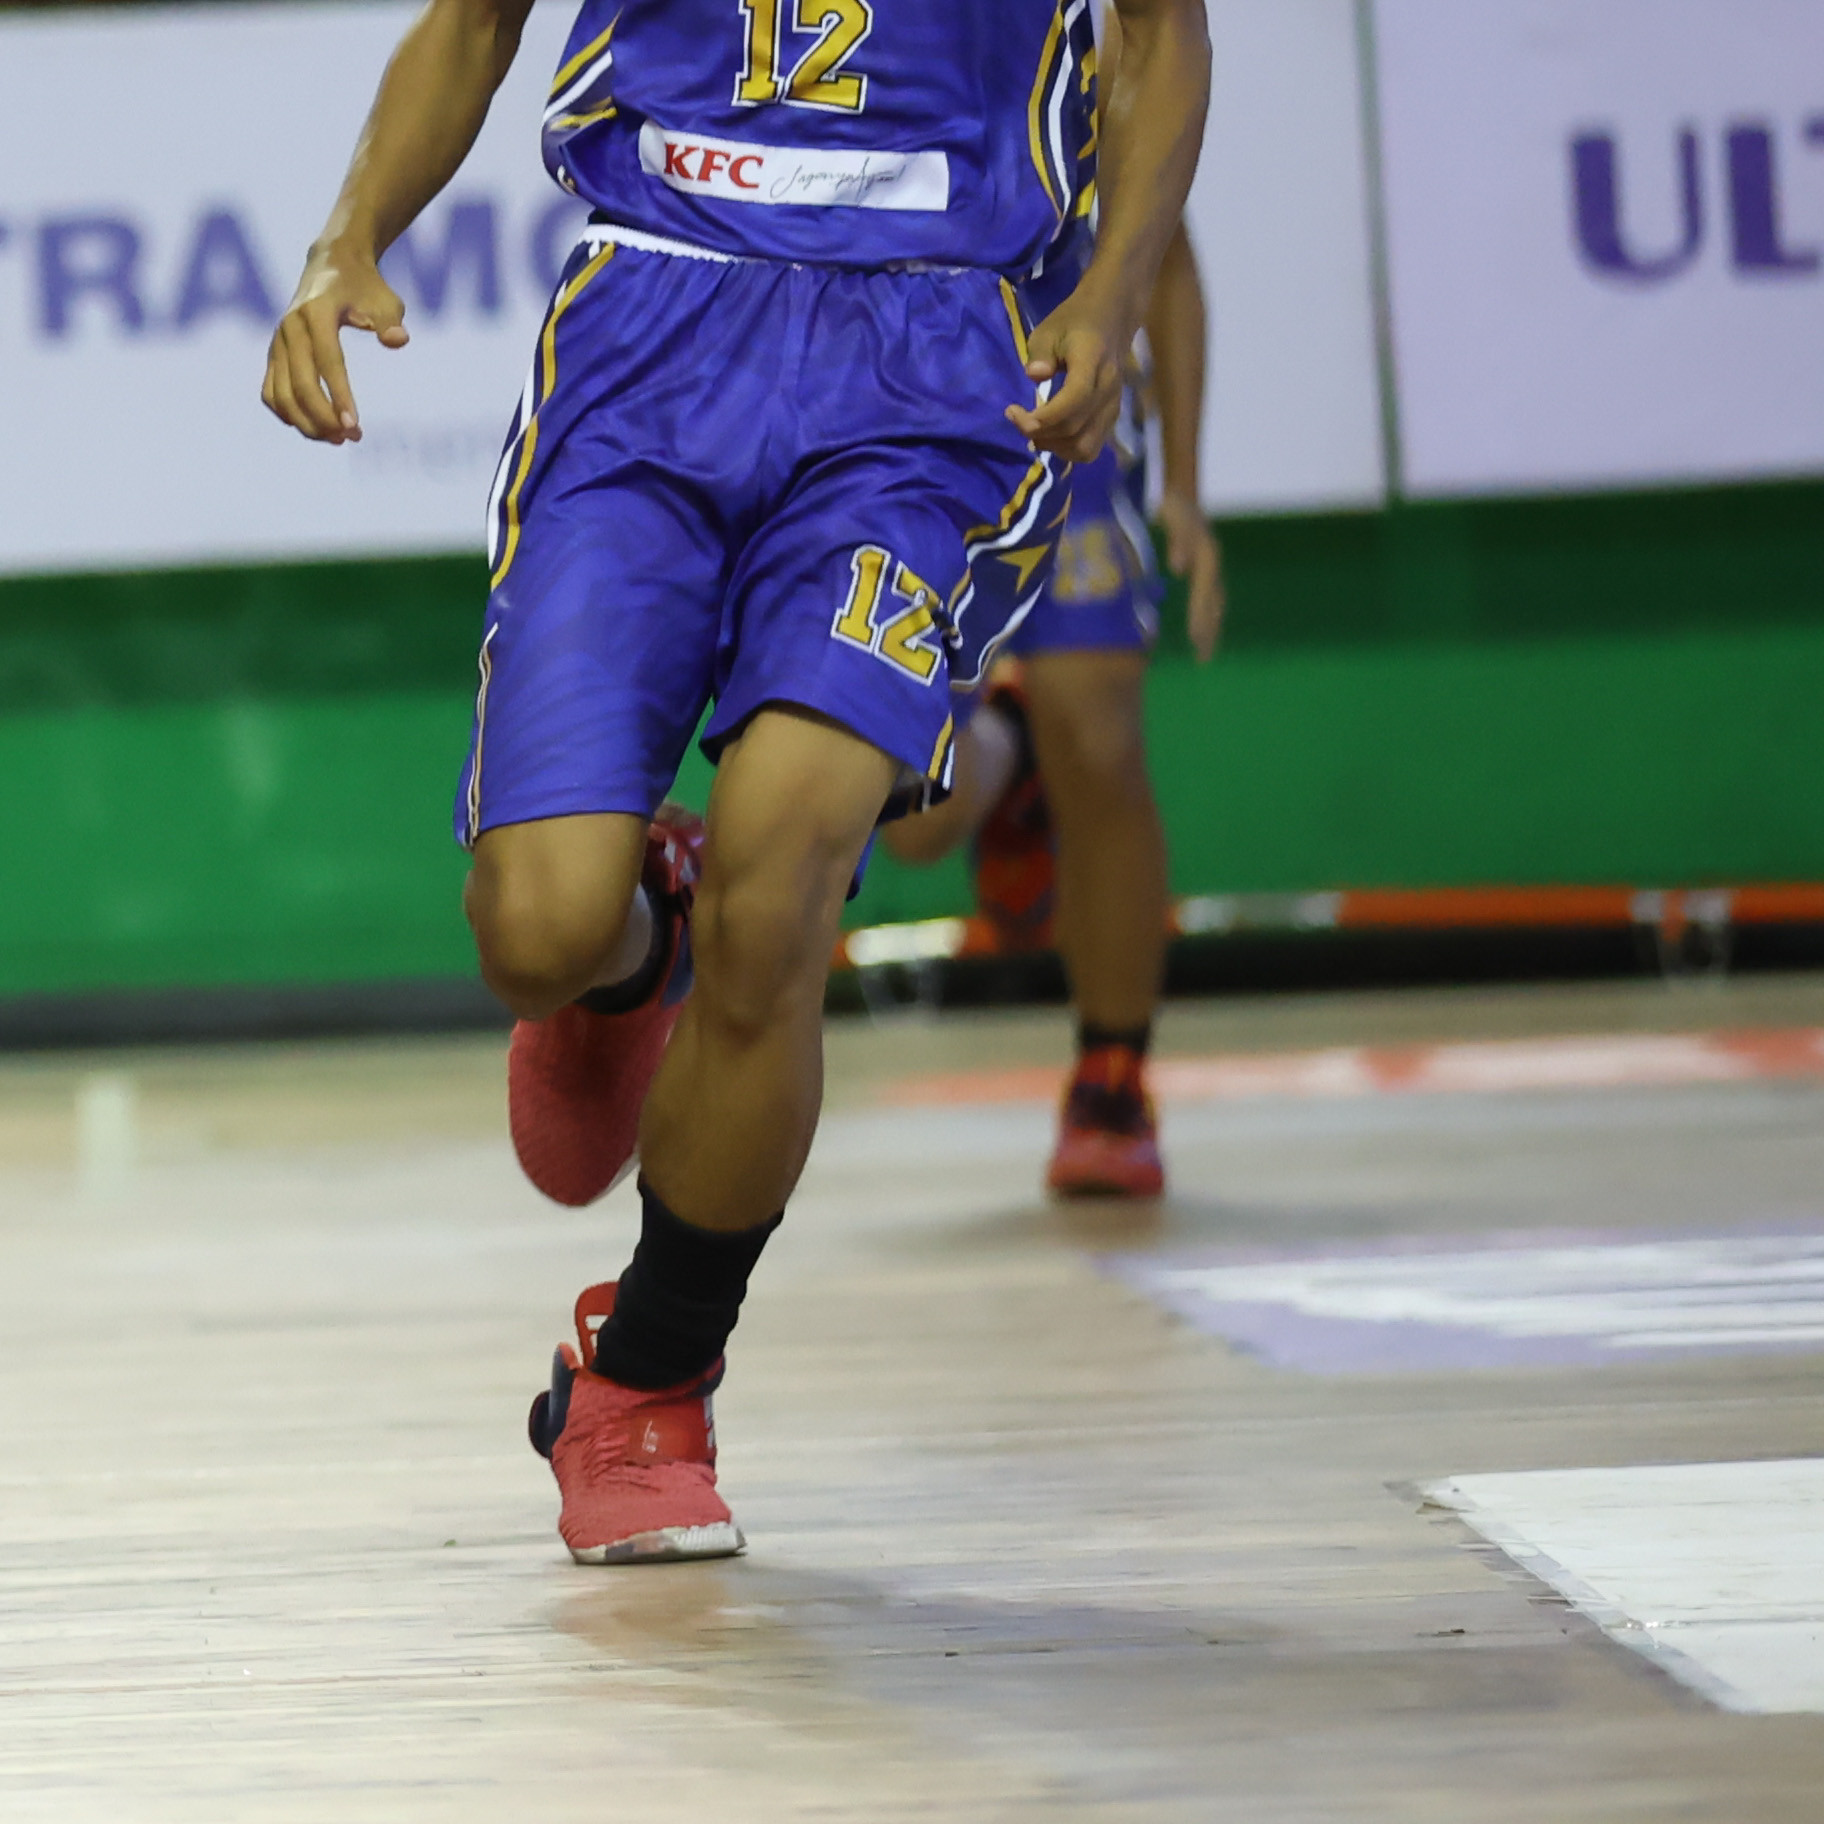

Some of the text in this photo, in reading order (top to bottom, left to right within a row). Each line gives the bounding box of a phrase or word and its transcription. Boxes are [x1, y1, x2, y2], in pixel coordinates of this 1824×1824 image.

[664, 143, 764, 190] KFC
[1568, 116, 1824, 288] UL
[830, 544, 943, 687] 12
